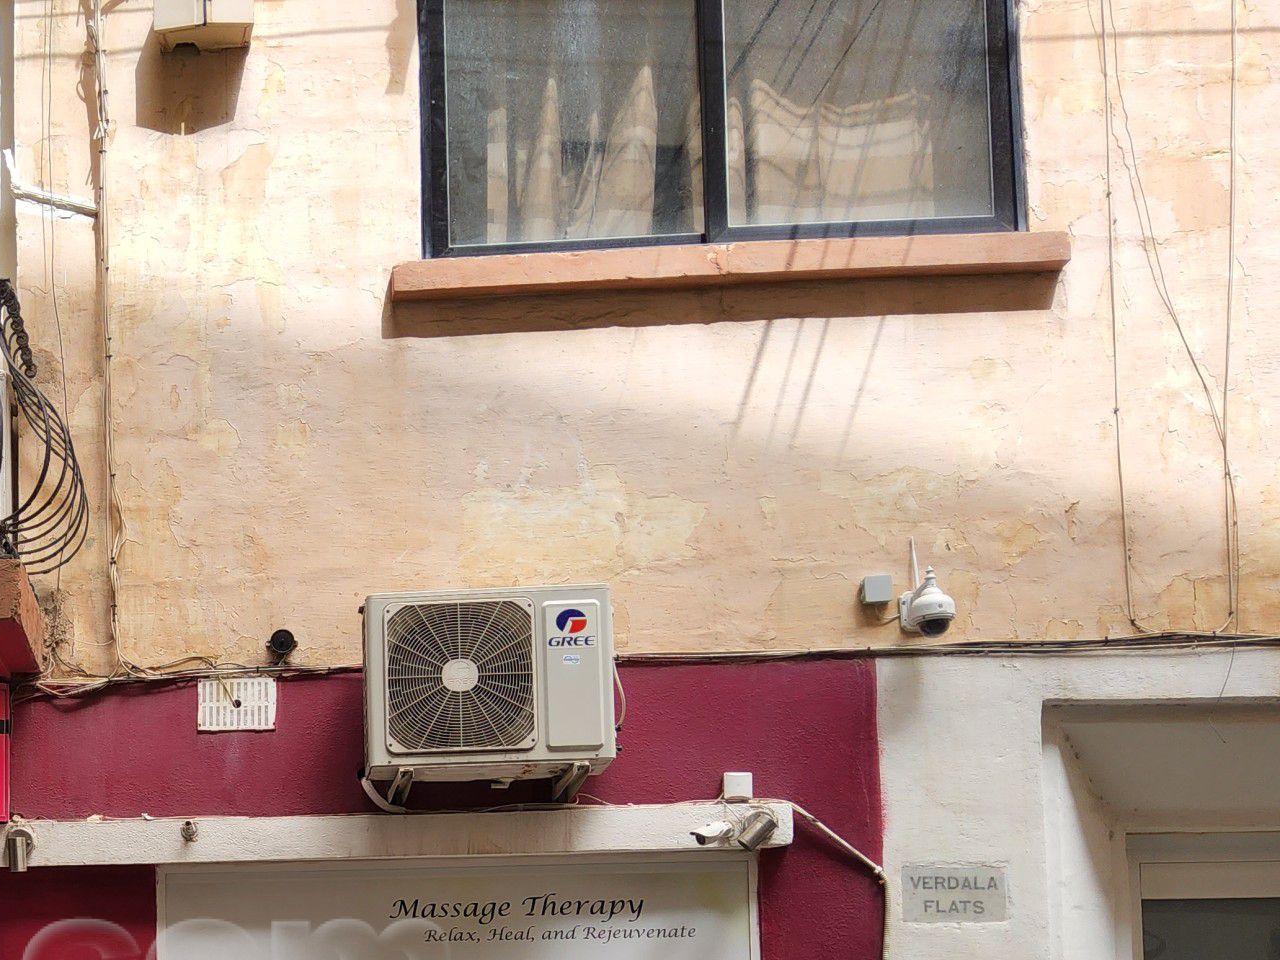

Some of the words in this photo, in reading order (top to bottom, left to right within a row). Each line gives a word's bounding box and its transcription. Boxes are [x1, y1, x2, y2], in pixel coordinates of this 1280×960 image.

[548, 634, 596, 647] GREE
[910, 876, 999, 891] VERDALA
[389, 897, 511, 924] Massage
[521, 893, 644, 922] Therapy
[923, 900, 985, 914] FLATS
[424, 928, 481, 943] Relax,
[487, 926, 535, 943] Heal,
[541, 926, 577, 941] and
[583, 925, 697, 944] Rejeuvenate
